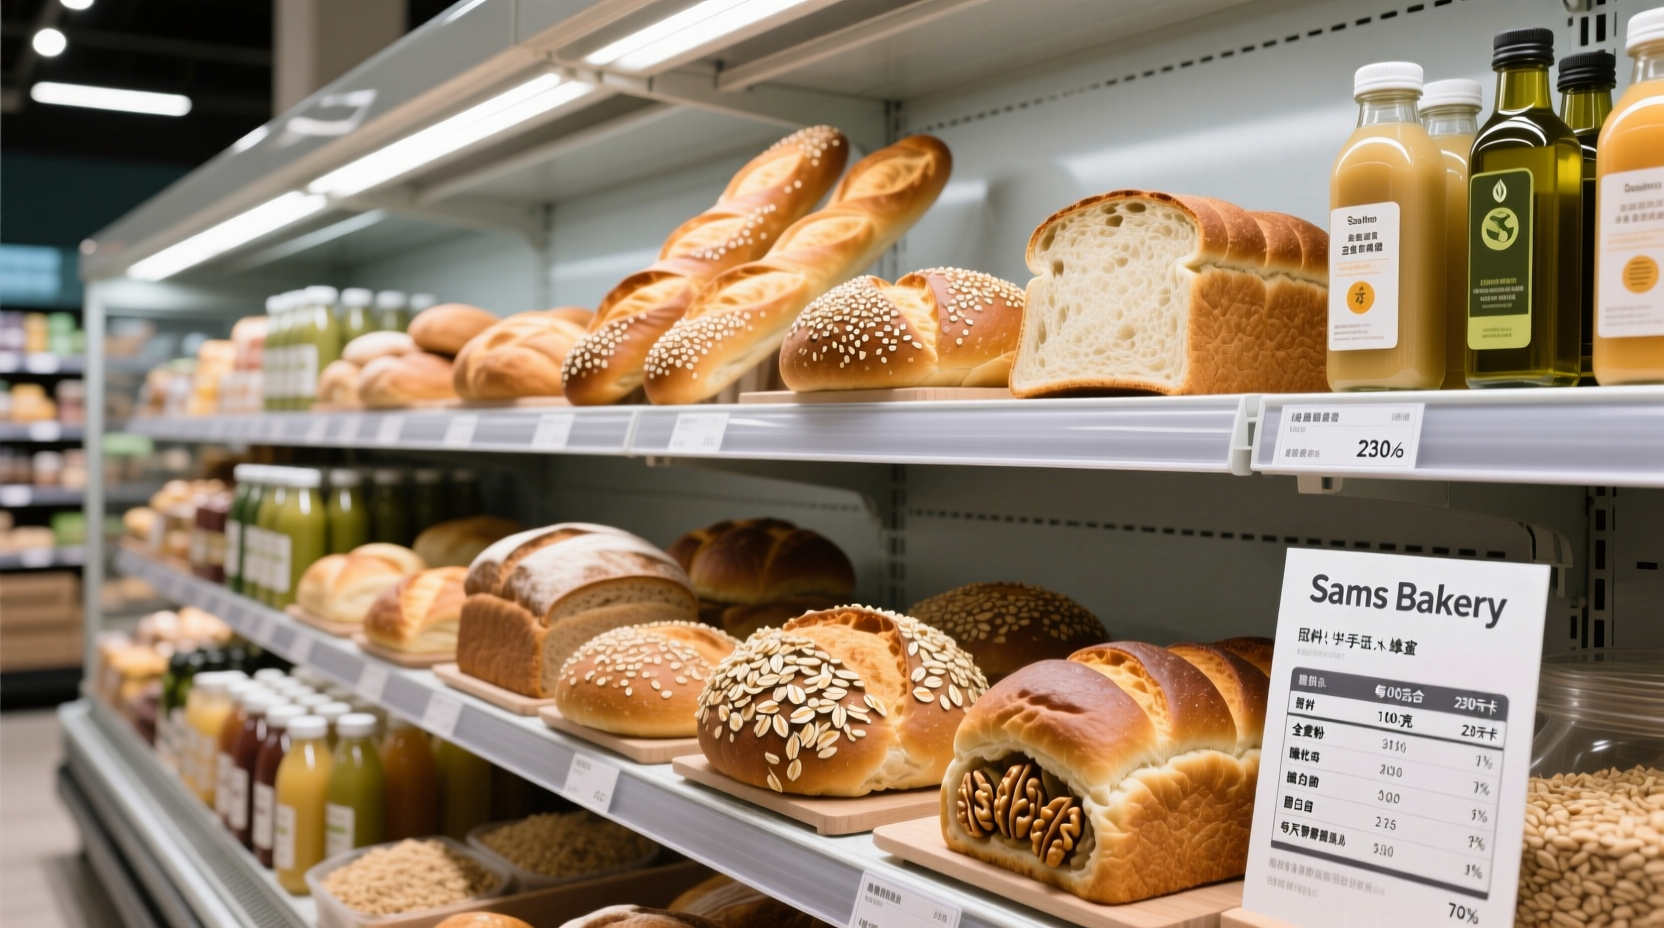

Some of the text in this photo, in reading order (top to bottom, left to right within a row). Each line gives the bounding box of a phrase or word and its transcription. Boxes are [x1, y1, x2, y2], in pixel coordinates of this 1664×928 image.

[1309, 574, 1508, 629] Sams Bakery
[1448, 902, 1479, 925] 70%
